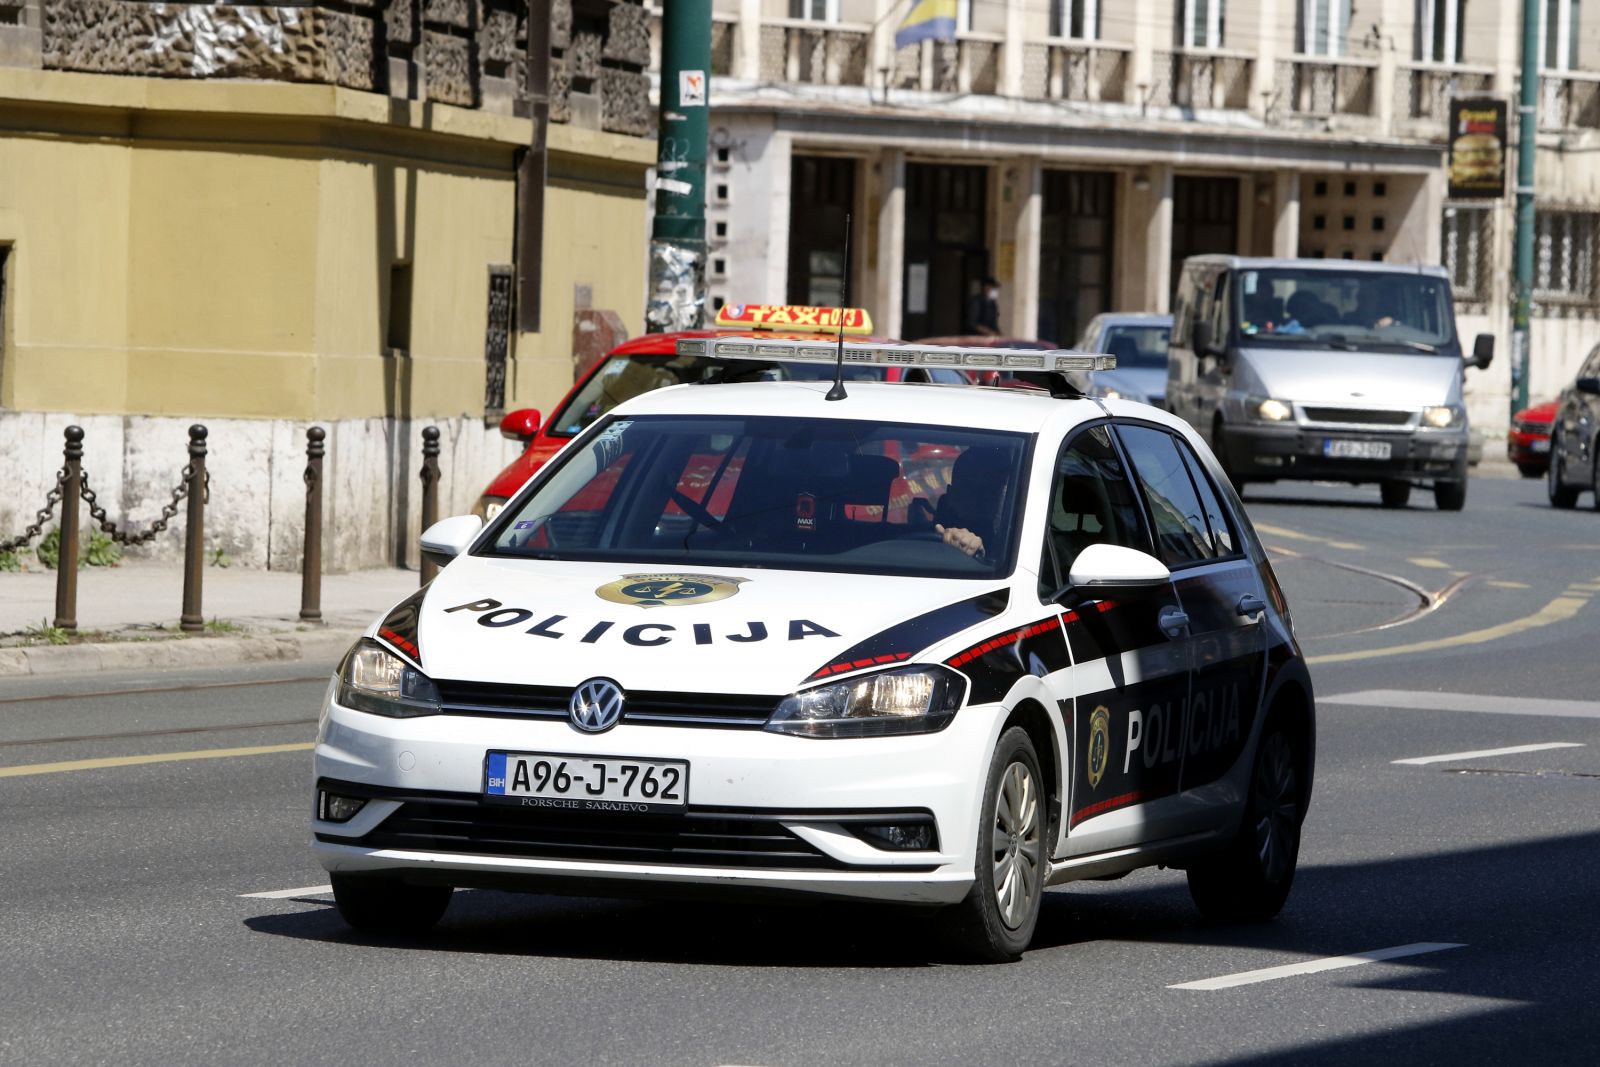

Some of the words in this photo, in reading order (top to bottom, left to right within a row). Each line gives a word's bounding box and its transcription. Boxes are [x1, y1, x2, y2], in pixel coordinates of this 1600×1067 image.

[747, 308, 830, 325] TAXI
[797, 517, 814, 525] MAX
[444, 598, 842, 647] POLICIJA
[1123, 681, 1239, 774] POLICIJA
[488, 777, 505, 788] BIH
[511, 759, 680, 800] A96-J-762
[521, 798, 579, 809] PORSCHE
[586, 800, 649, 813] SARAJEVO
